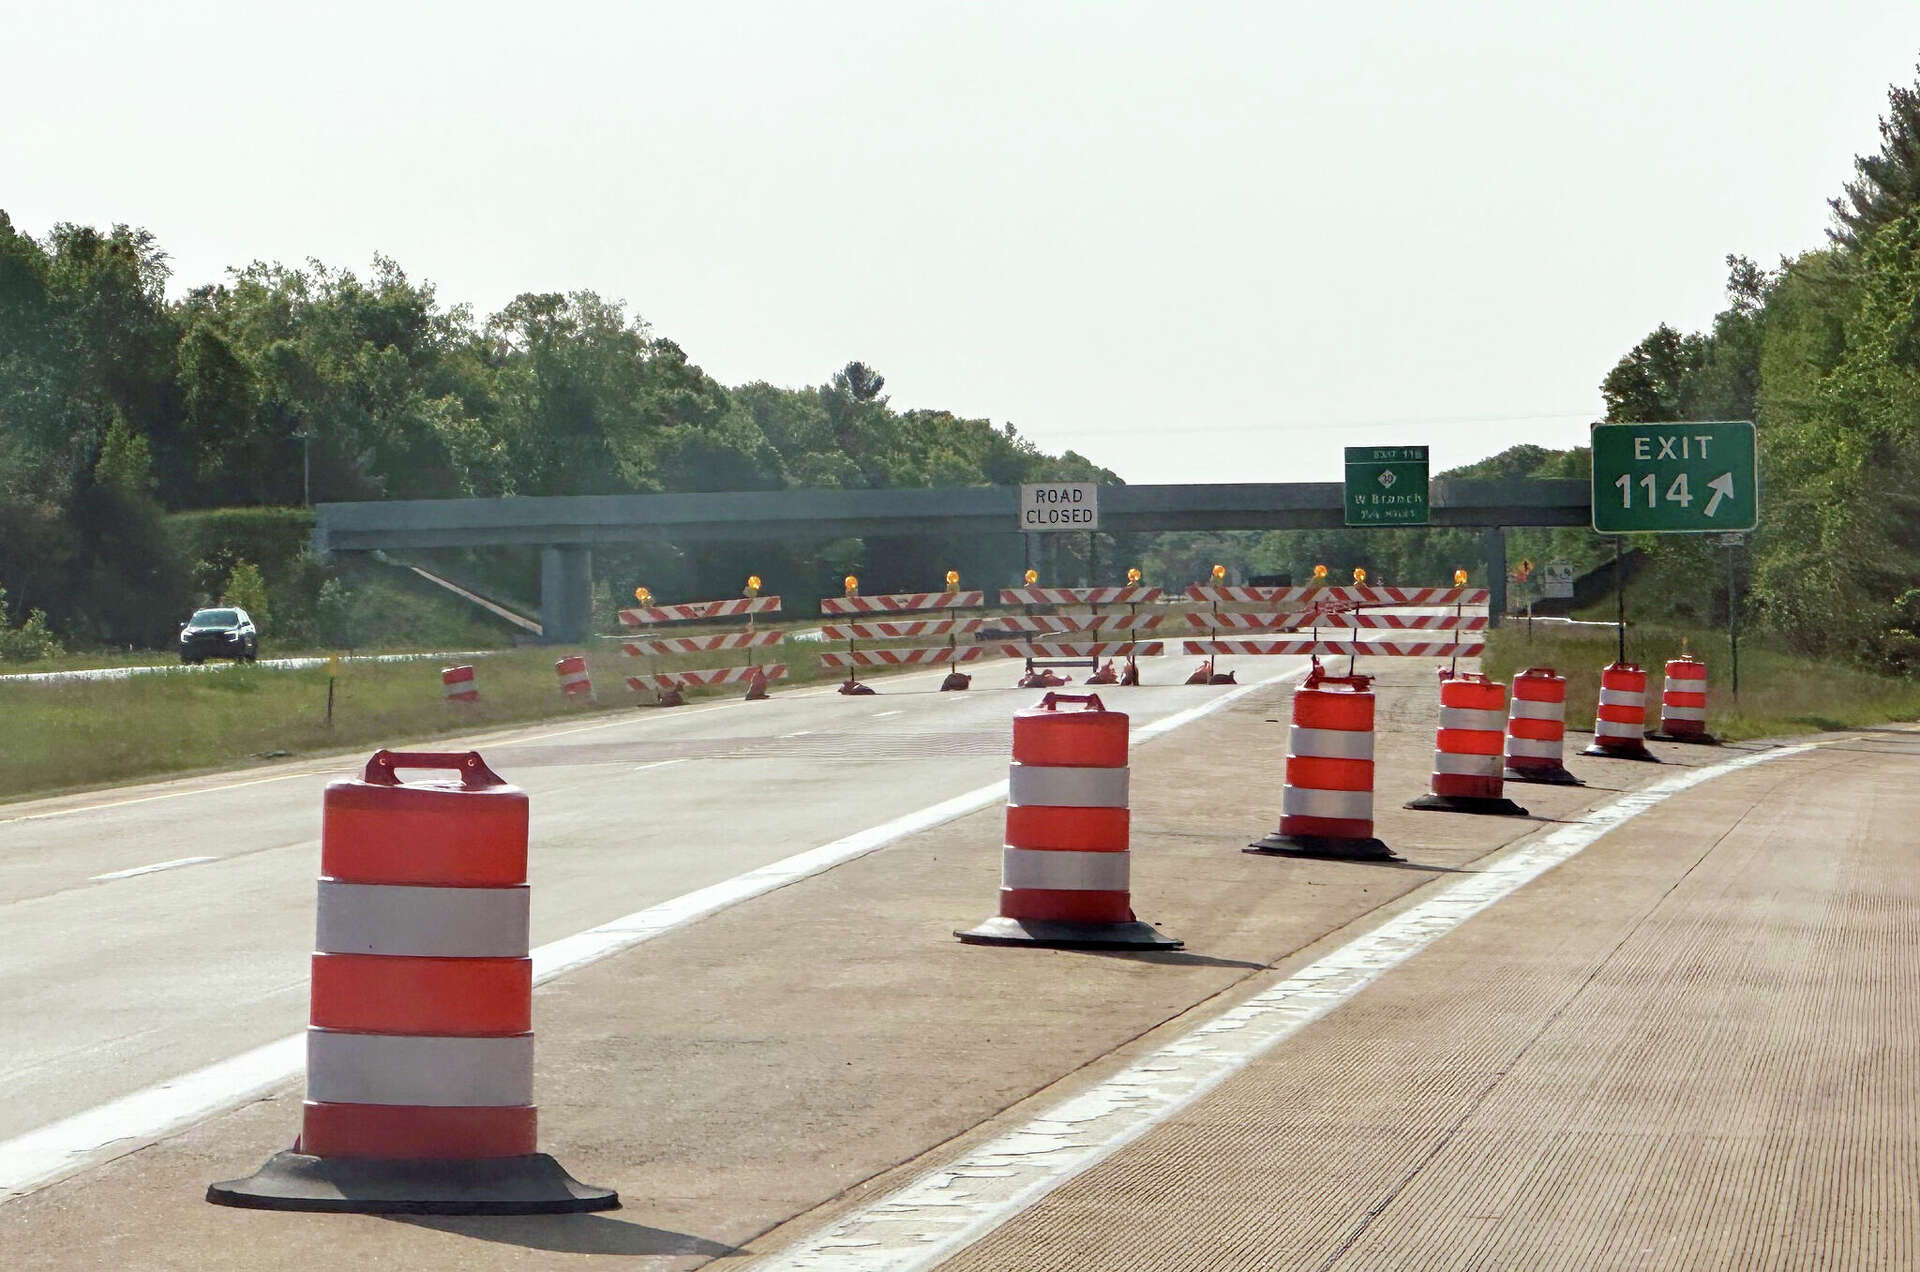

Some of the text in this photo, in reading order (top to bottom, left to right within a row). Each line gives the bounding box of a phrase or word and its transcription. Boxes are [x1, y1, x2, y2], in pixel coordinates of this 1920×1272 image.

[1635, 436, 1713, 460] EXIT
[1036, 488, 1083, 504] ROAD
[1615, 473, 1694, 509] 114
[1372, 494, 1423, 505] Branch
[1026, 509, 1093, 524] CLOSED
